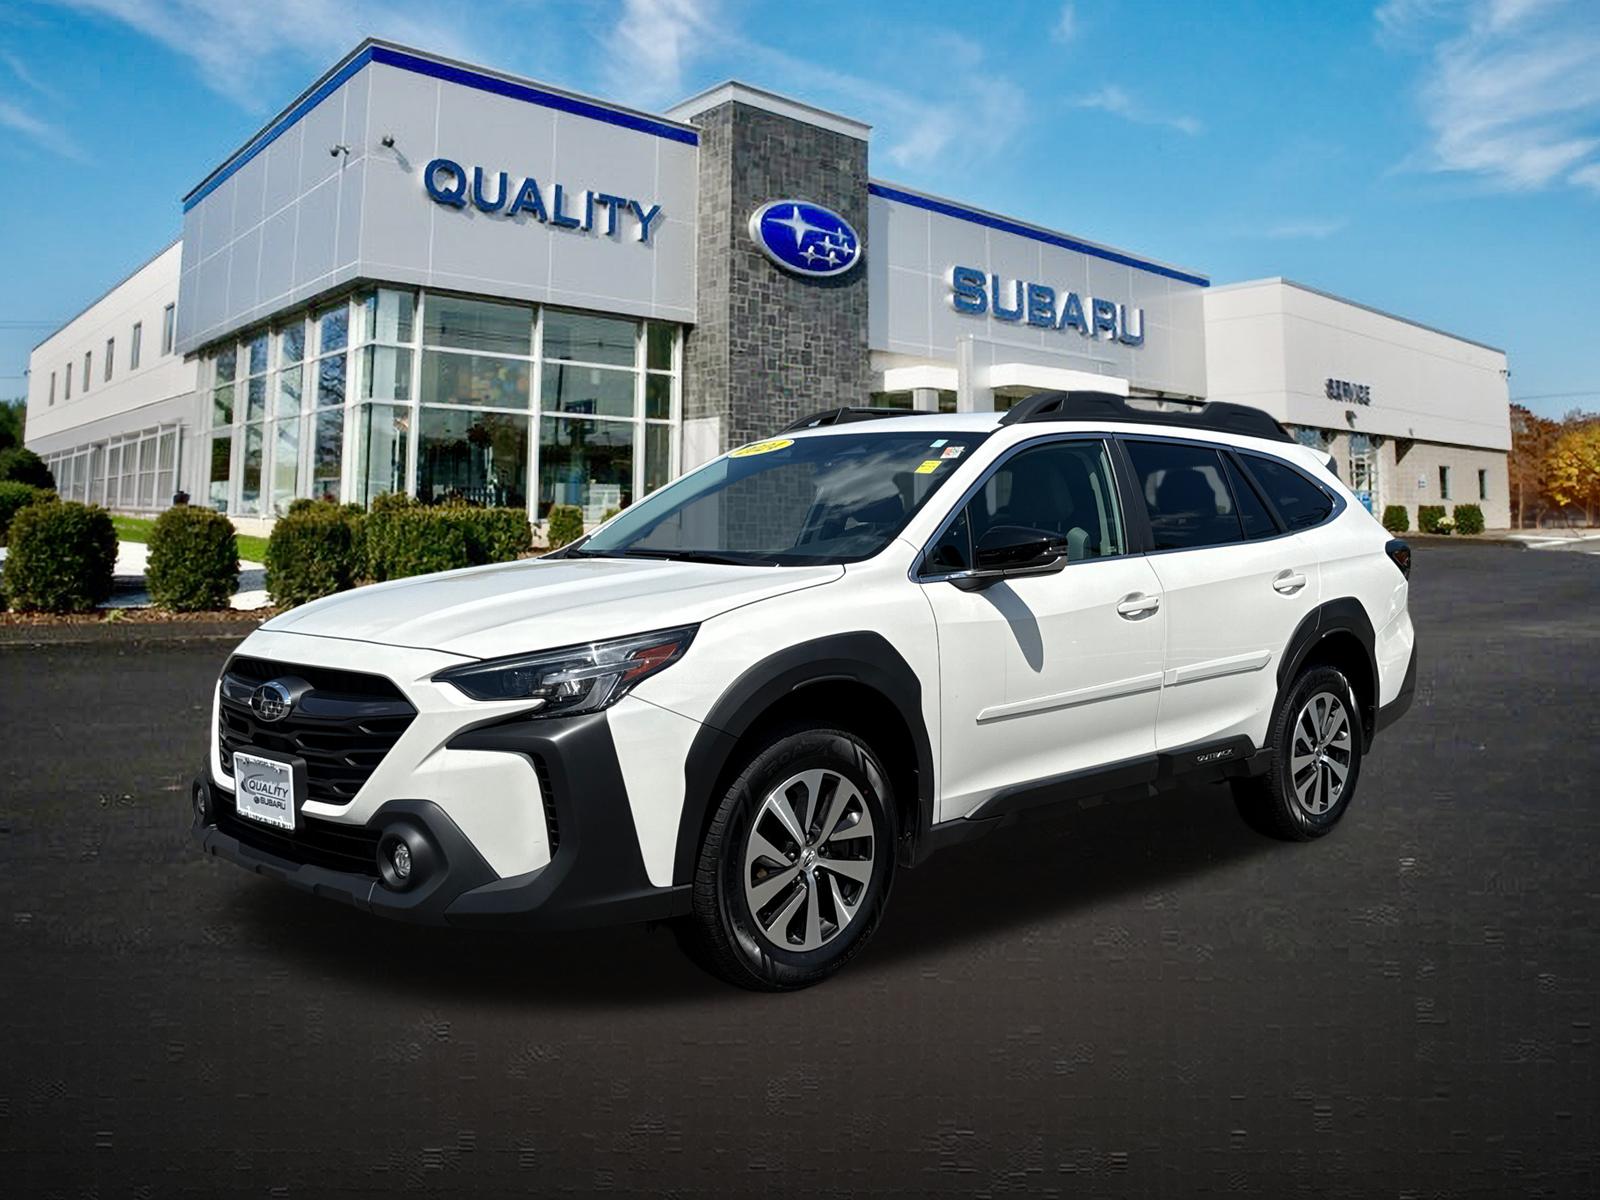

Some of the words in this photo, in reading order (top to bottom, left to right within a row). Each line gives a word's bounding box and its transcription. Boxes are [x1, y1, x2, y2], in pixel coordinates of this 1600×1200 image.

[424, 158, 661, 243] QUALITY
[952, 265, 1145, 347] SUBARU
[248, 779, 289, 799] QUALITY
[260, 796, 286, 810] SUBARU
